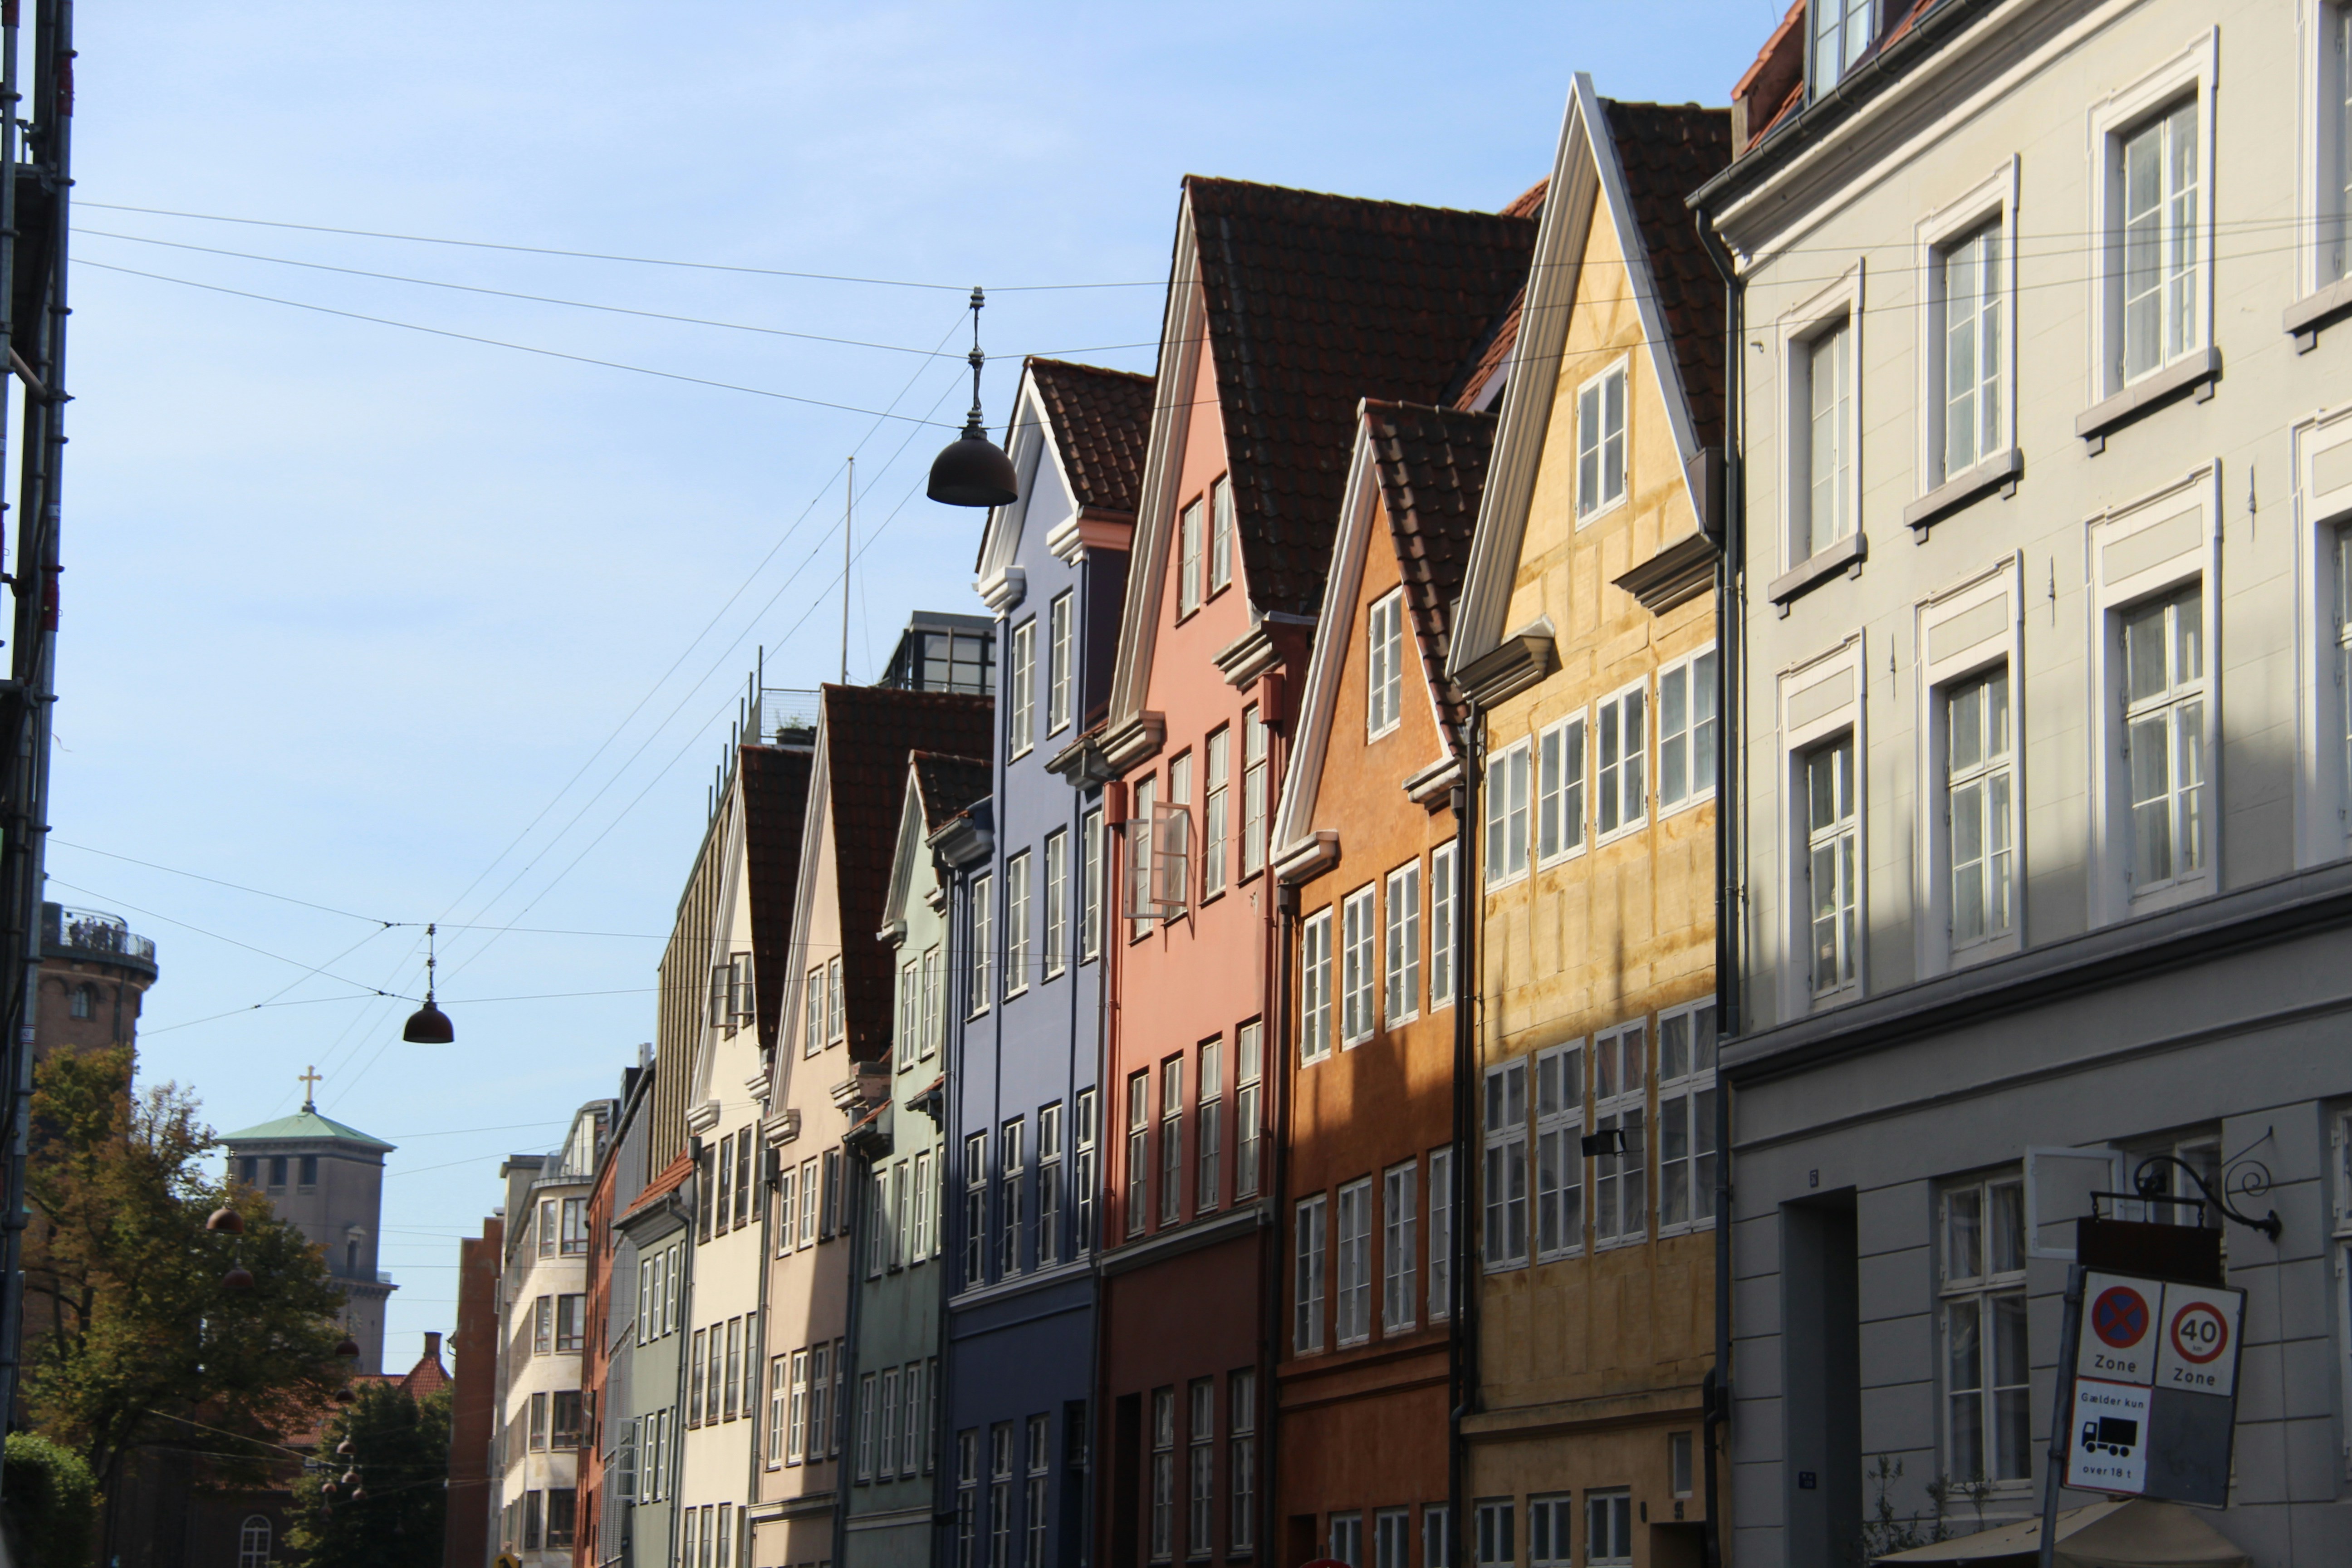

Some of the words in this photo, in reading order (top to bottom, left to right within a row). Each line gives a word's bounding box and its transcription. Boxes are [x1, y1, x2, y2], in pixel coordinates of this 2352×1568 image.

[2180, 1319, 2216, 1343] 40
[2095, 1354, 2136, 1373] Zone
[2173, 1367, 2215, 1386] Zone
[2081, 1392, 2122, 1405] Gælder
[2125, 1398, 2144, 1408] kun
[2083, 1466, 2107, 1475] over
[2112, 1467, 2123, 1477] 18
[2127, 1470, 2131, 1479] t
